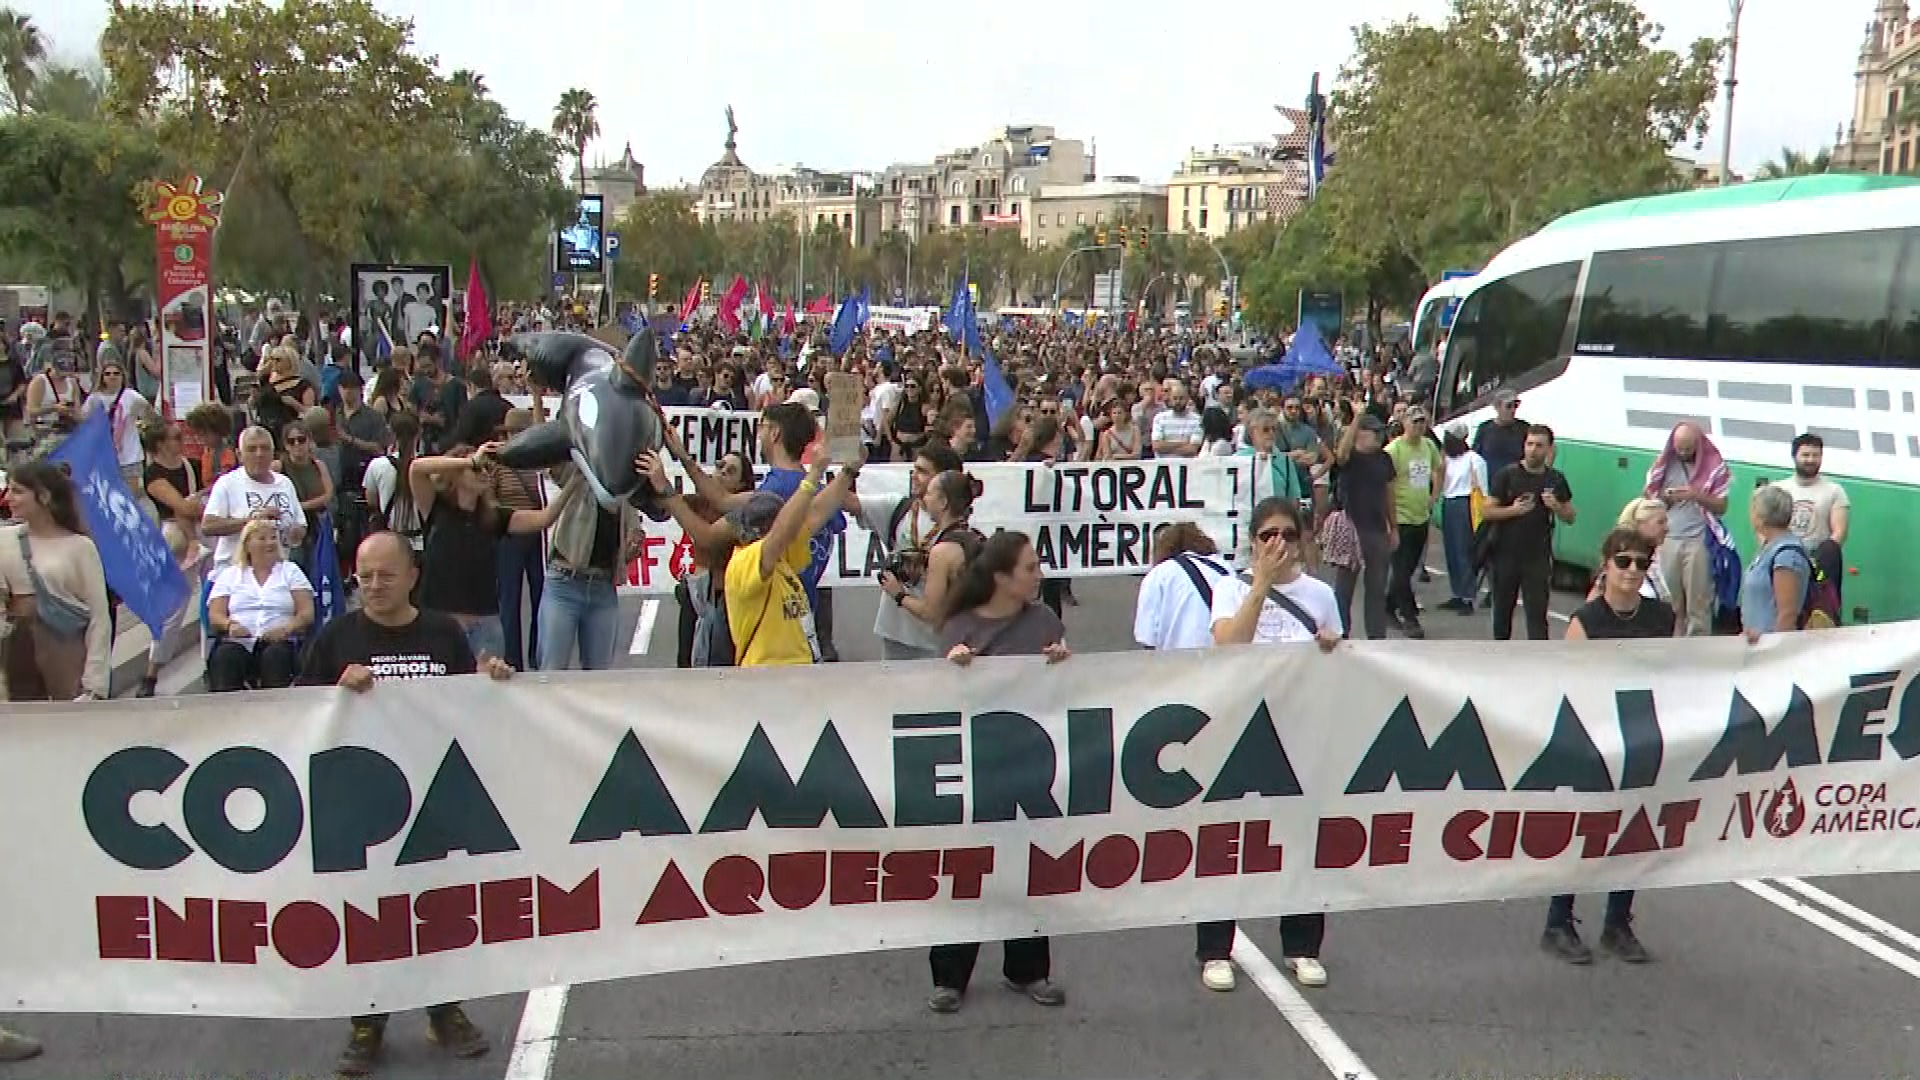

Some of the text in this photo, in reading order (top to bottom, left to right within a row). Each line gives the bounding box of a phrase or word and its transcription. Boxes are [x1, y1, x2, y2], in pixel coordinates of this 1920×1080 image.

[606, 237, 618, 253] P
[1024, 465, 1205, 512] LITORAL
[430, 662, 447, 675] NO
[82, 738, 520, 872] COPA
[1344, 690, 1663, 794] MAI
[1815, 783, 1886, 806] COPA
[1811, 804, 1920, 835] AMÈRIC
[96, 798, 1701, 968] ENFONSEM AQUEST MODEL DE CIUTAT
